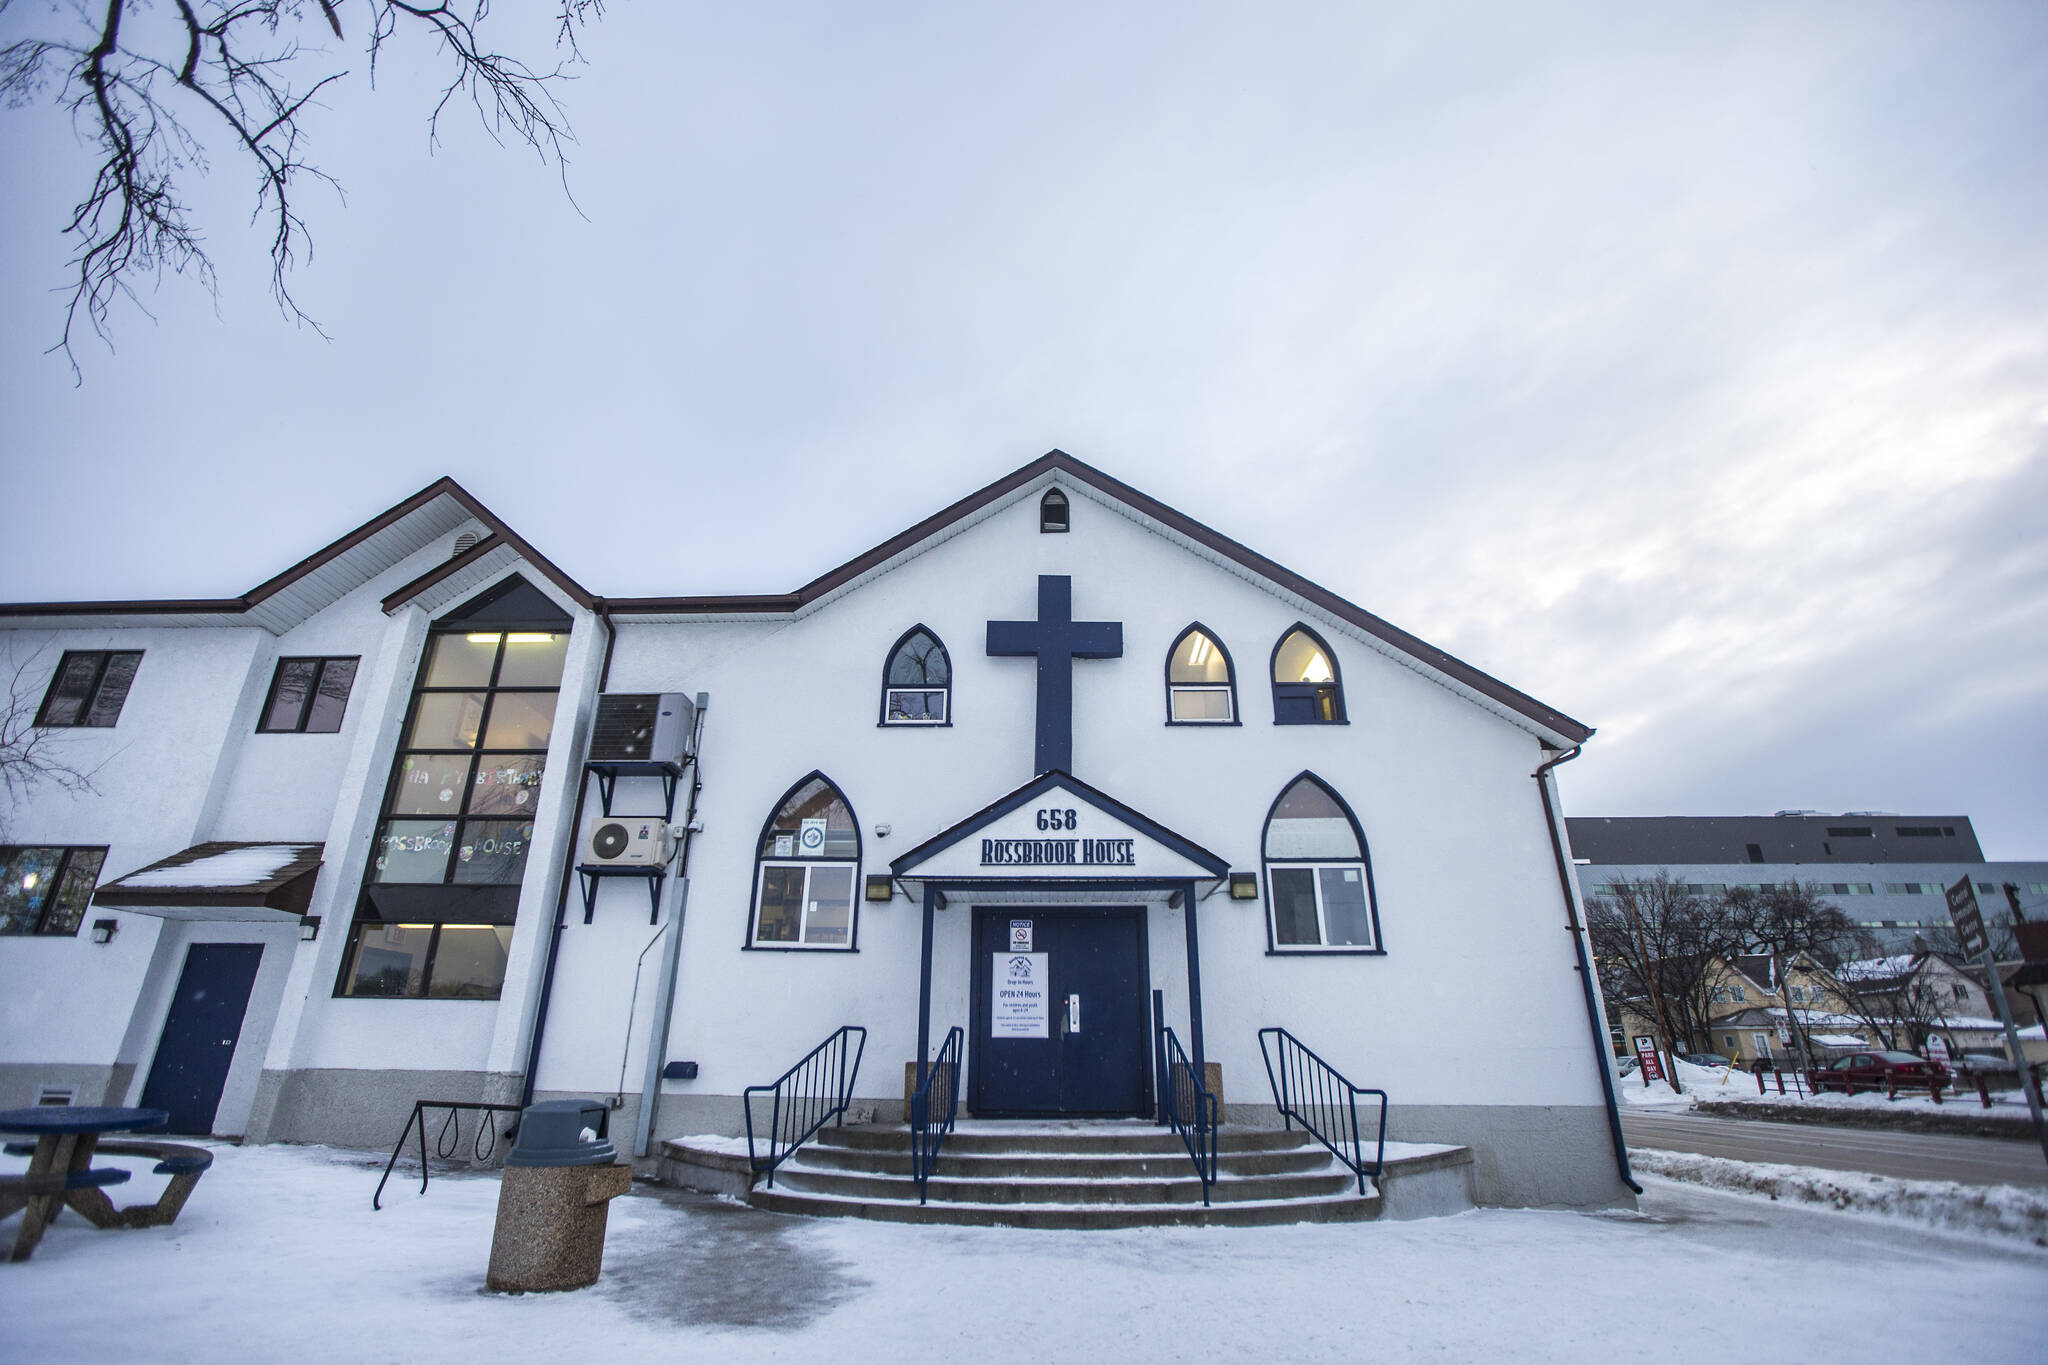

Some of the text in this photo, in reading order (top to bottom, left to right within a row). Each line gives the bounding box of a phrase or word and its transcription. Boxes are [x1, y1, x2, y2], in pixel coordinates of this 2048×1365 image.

[1036, 808, 1077, 831] 658
[981, 838, 1135, 864] ROSSBROOK HOUSE
[999, 990, 1041, 998] OPEN 24 Hours
